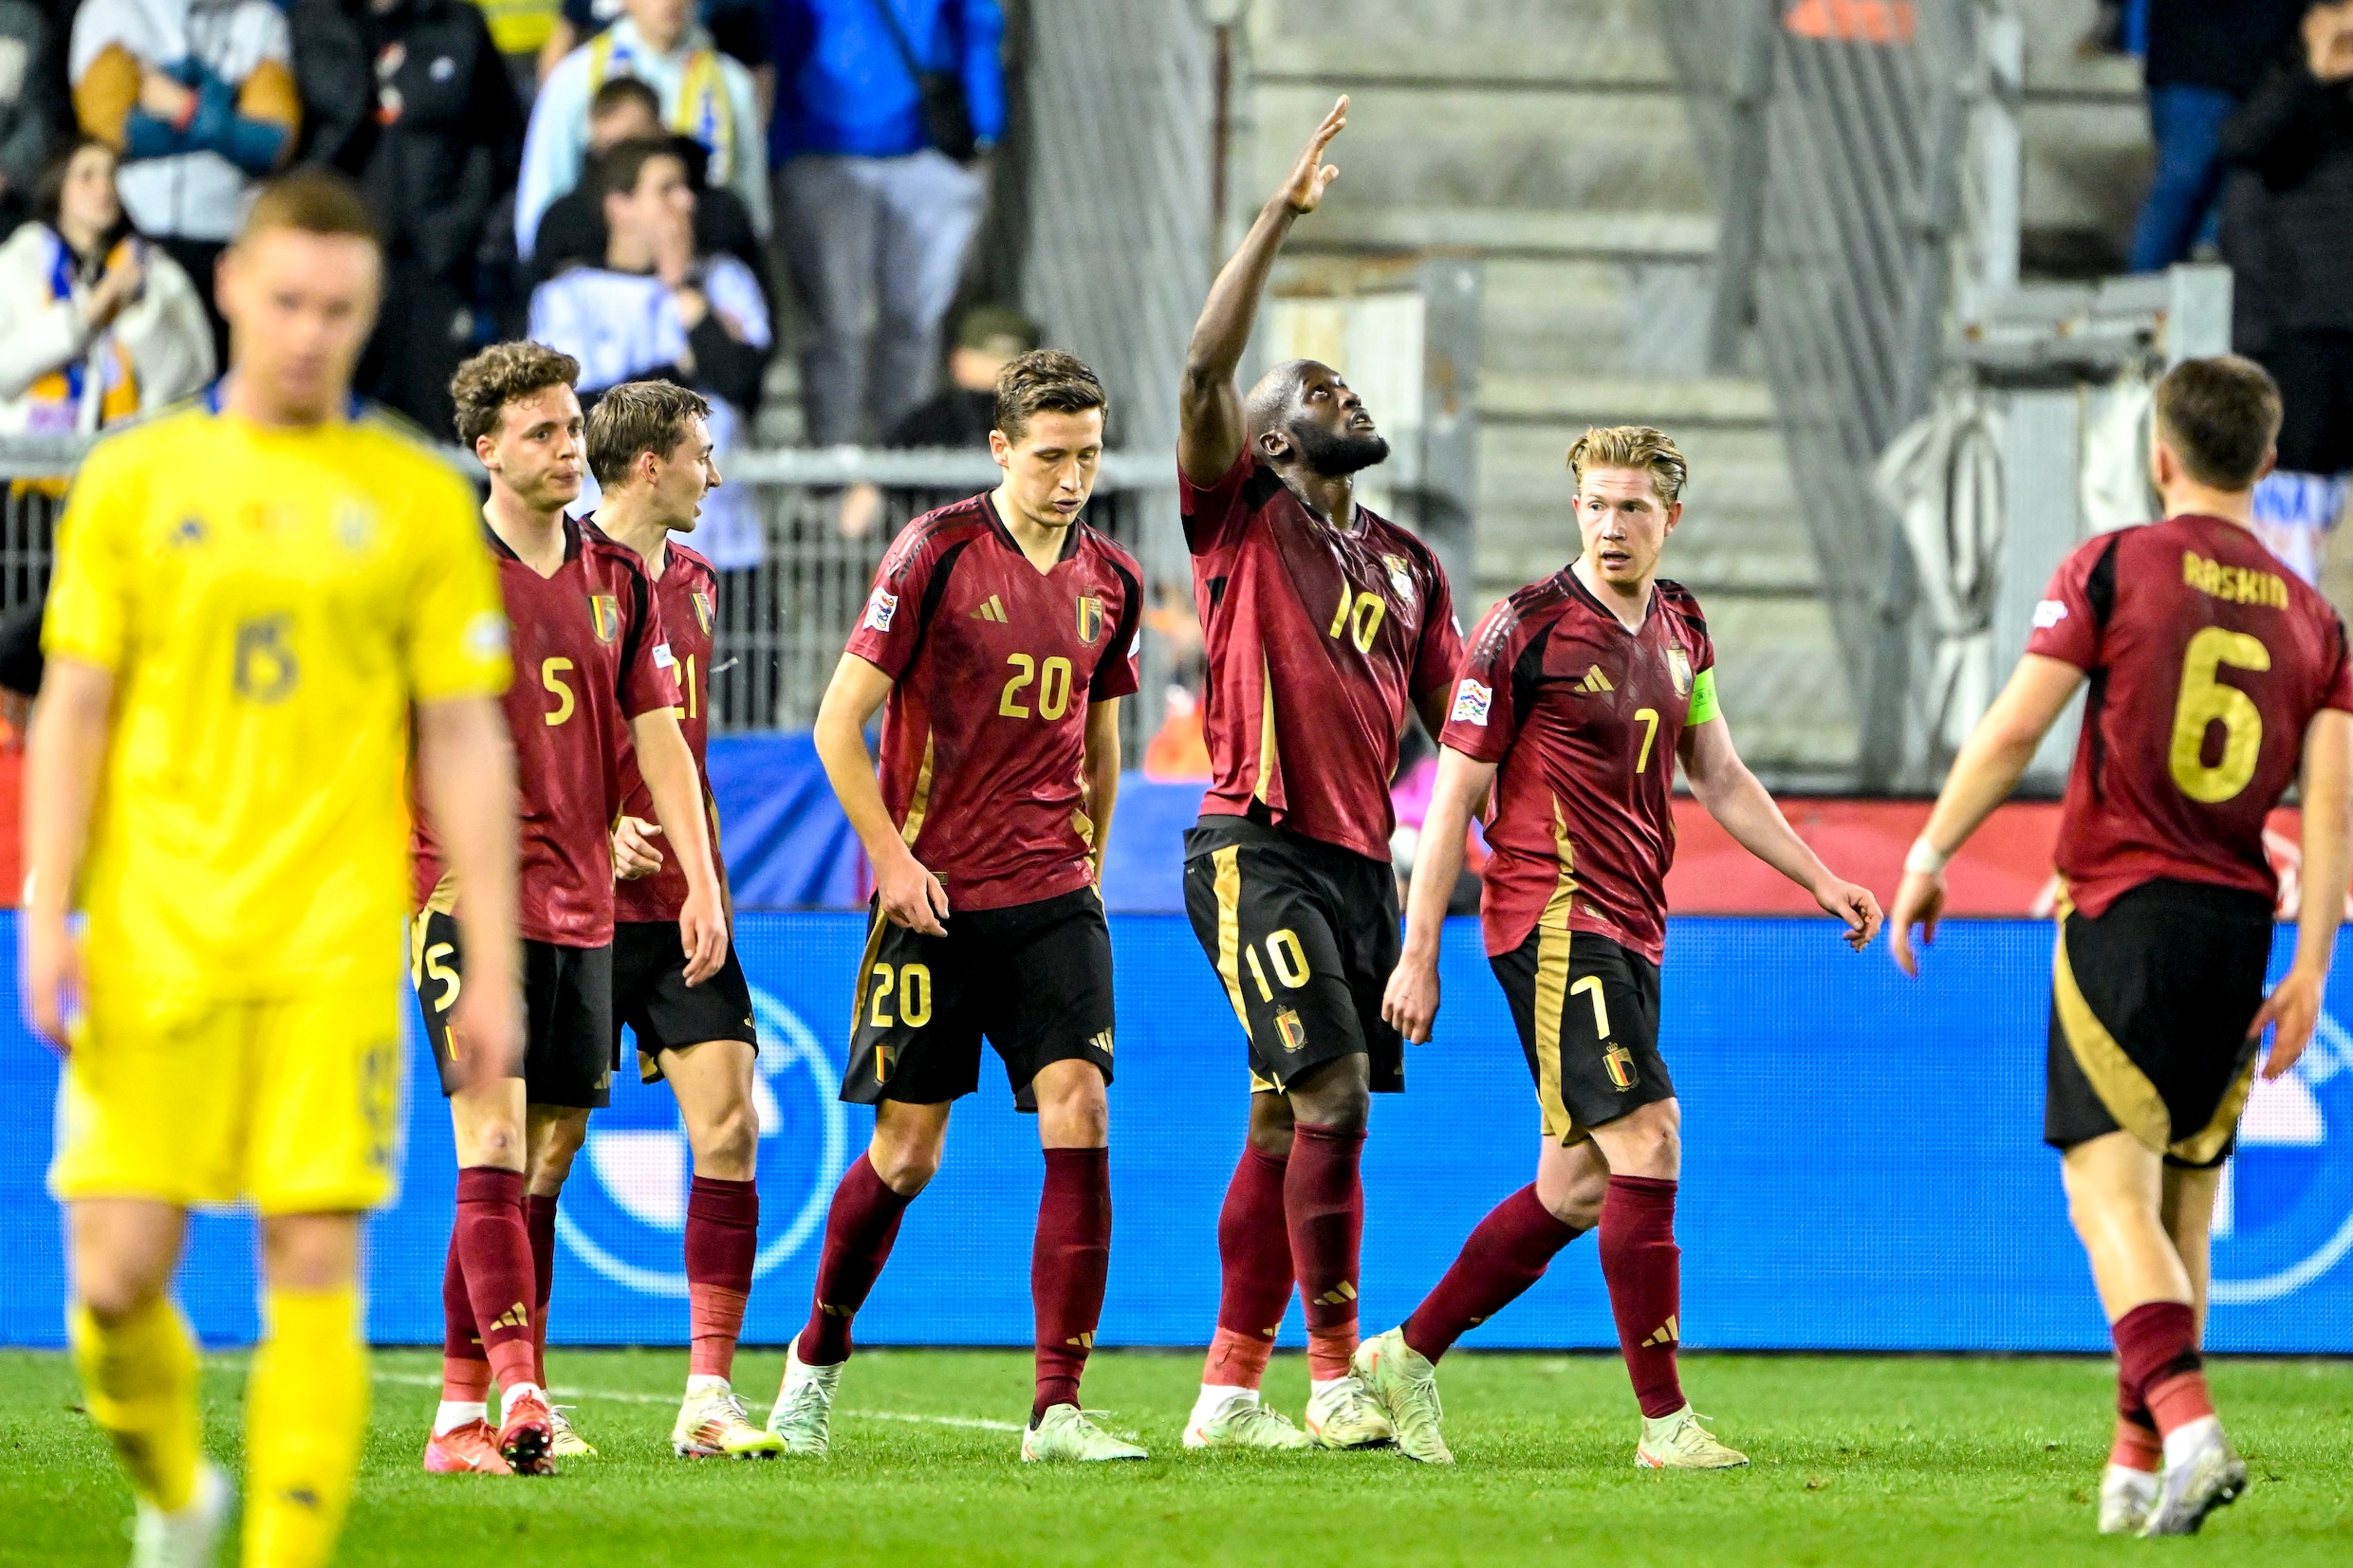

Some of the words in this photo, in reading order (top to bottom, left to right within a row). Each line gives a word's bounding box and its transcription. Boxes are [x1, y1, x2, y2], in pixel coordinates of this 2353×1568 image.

[1329, 581, 1385, 654] 10
[542, 656, 575, 727] 5
[999, 653, 1072, 721] 20
[2169, 626, 2270, 803] 6
[1634, 708, 1658, 774] 7
[425, 942, 461, 1013] 5
[870, 962, 932, 1028] 20
[1245, 929, 1310, 1003] 10
[1570, 975, 1610, 1041] 7
